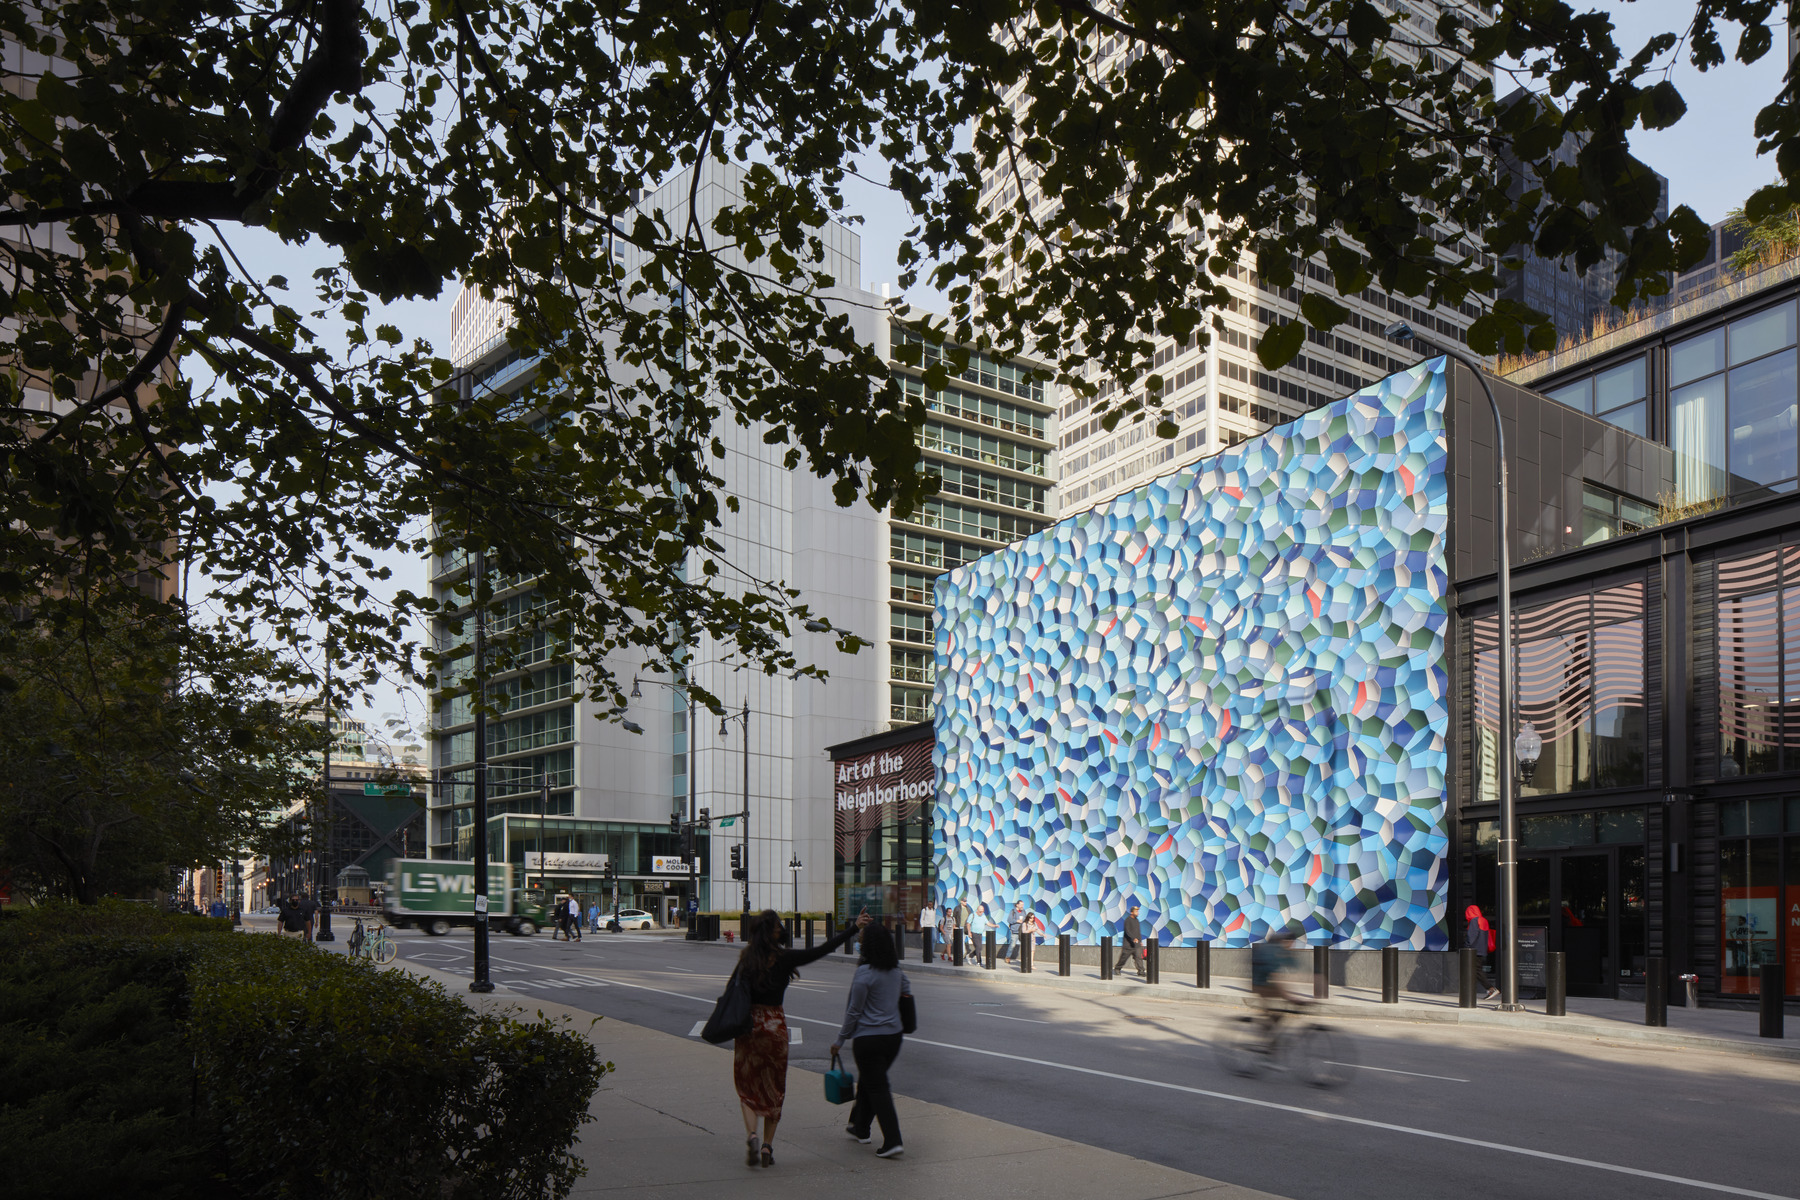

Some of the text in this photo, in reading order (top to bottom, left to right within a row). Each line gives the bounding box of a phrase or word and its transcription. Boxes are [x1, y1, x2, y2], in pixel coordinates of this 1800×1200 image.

[837, 753, 903, 784] Art of the
[531, 856, 602, 869] Walgreens
